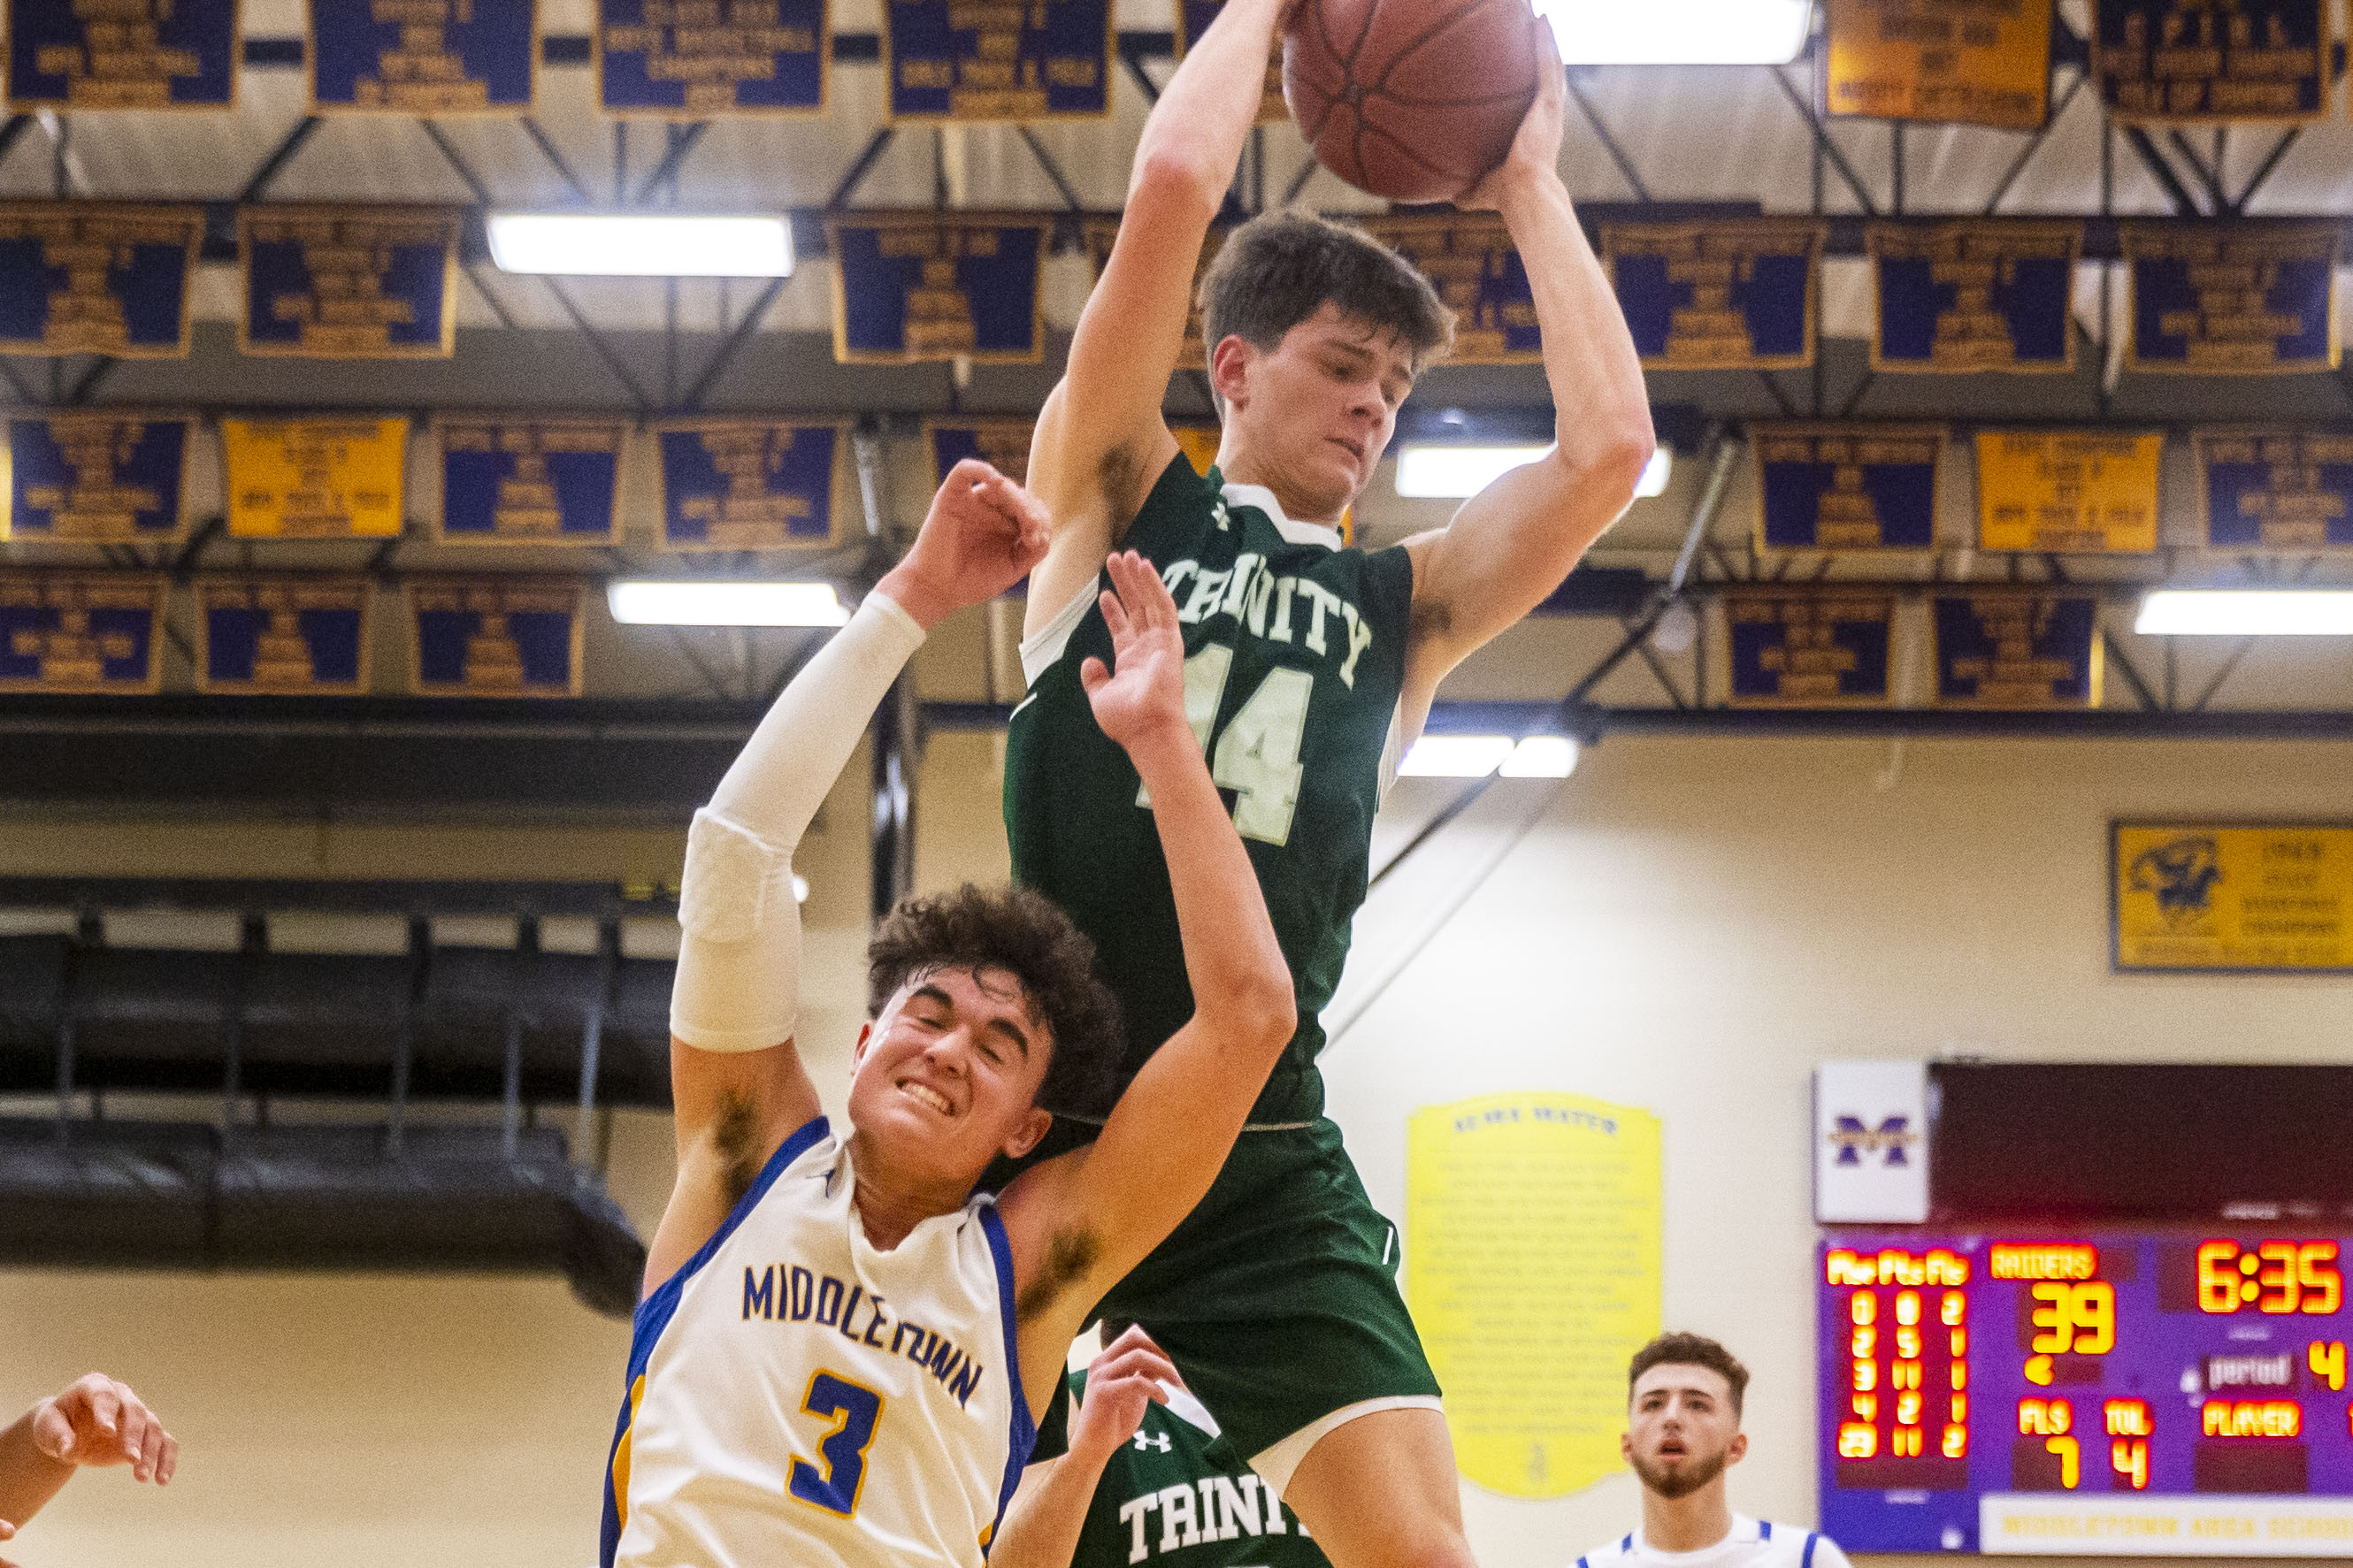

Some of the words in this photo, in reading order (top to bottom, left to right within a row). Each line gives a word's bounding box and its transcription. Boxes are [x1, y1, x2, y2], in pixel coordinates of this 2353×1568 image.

[1162, 552, 1372, 691] TRINITY
[1990, 1243, 2097, 1279] RAIDERS
[2197, 1240, 2342, 1314] 6:35
[741, 1262, 984, 1411] MIDDLETOWN
[1941, 1289, 1966, 1326] 2
[2031, 1281, 2115, 1354] 39
[2309, 1340, 2347, 1391] 4
[785, 1367, 885, 1519] 3
[2202, 1399, 2302, 1437] PLAYER
[2045, 1435, 2080, 1489] 7
[2112, 1438, 2150, 1490] 4
[1119, 1474, 1311, 1564] TRINI
